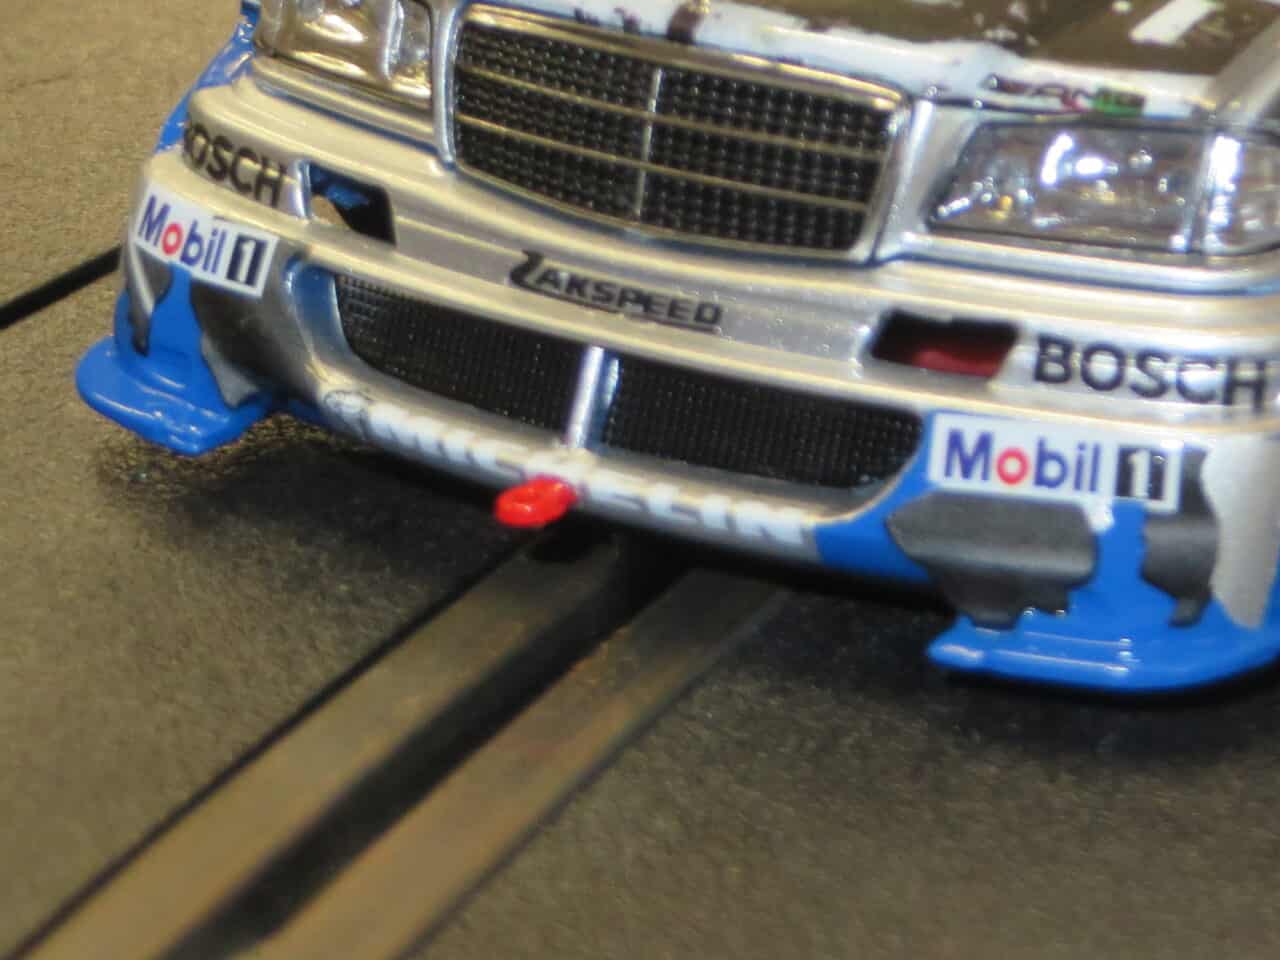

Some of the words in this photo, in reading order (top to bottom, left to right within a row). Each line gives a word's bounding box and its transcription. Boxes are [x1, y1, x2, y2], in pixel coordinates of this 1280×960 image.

[184, 124, 288, 208] OSCH
[138, 194, 228, 275] Mobil
[509, 249, 724, 329] ZAKSPEED
[1033, 334, 1270, 411] BOSCH
[943, 428, 1099, 493] Mobil
